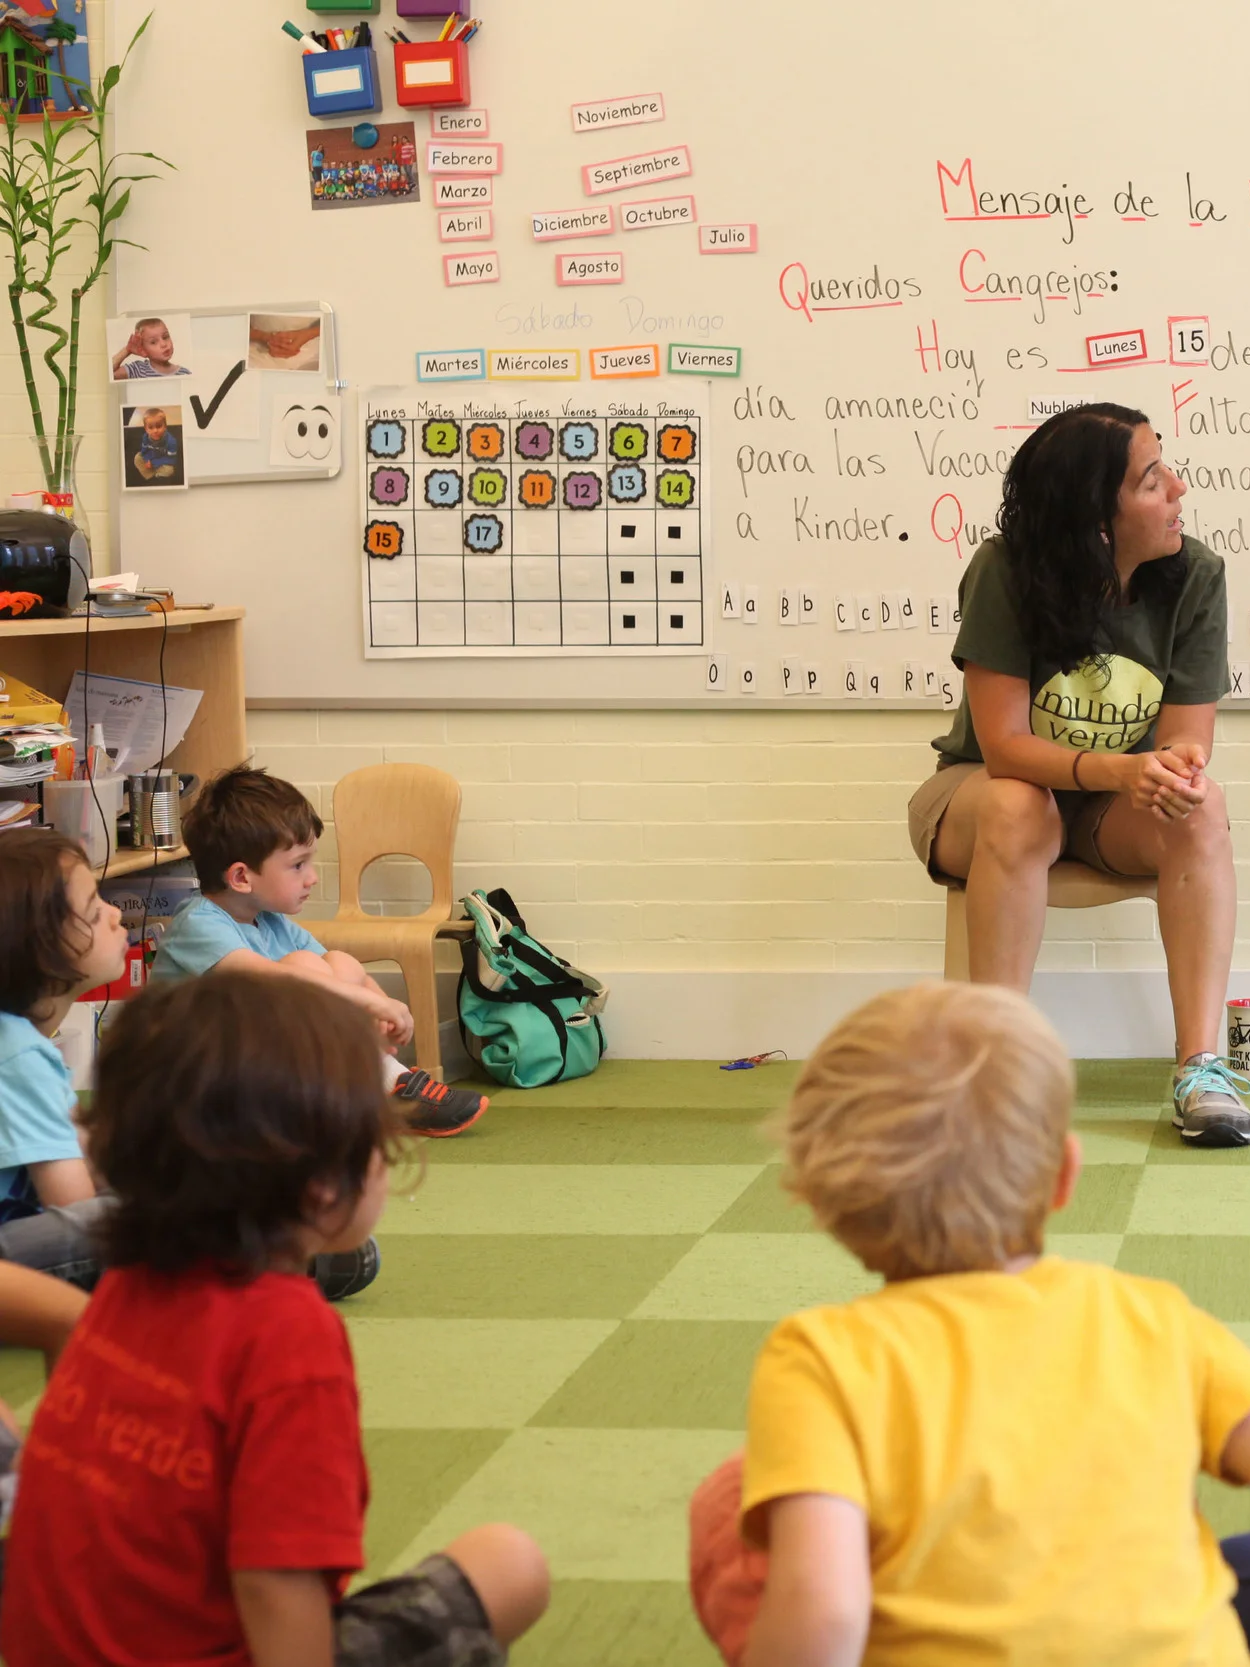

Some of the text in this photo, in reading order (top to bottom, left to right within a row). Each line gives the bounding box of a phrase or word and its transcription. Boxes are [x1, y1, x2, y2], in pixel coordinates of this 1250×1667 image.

[439, 114, 482, 130] Enero
[577, 101, 658, 125] Noviembre
[432, 151, 493, 166] Febrero
[594, 154, 681, 186] Septiembre
[440, 184, 487, 199] Marzo
[936, 158, 1093, 244] Mensaje
[1114, 181, 1159, 217] de
[1186, 172, 1227, 222] la
[533, 211, 608, 233] Diciembre
[626, 203, 689, 224] Octubre
[446, 217, 483, 233] Abril
[709, 230, 745, 244] Julio
[455, 260, 493, 277] Mayo
[567, 258, 619, 277] Agosto
[779, 249, 1118, 324] Queridos Cangrejos:
[495, 296, 724, 338] Sábado Domingo
[425, 351, 733, 373] Martes Miércoles Jueves Viernes
[915, 319, 984, 398] Hoy
[1006, 347, 1048, 370] es
[1095, 339, 1137, 357] Lunes
[1177, 330, 1205, 353] 15
[368, 398, 695, 422] Lunes Martes Miércoles Jueves Viernes Sábado Domingo
[734, 385, 796, 421] día
[825, 380, 979, 421] amaneció
[1031, 400, 1090, 415] Nublad
[383, 431, 682, 451] 1 2 3 4 5 6 7
[737, 445, 814, 498] para
[834, 429, 886, 477] las
[384, 476, 683, 498] 8 9 10 11 12 13 14
[737, 512, 759, 541] a
[794, 497, 908, 541] Kinder.
[375, 526, 492, 547] 15 17
[1041, 690, 1161, 725] mundo
